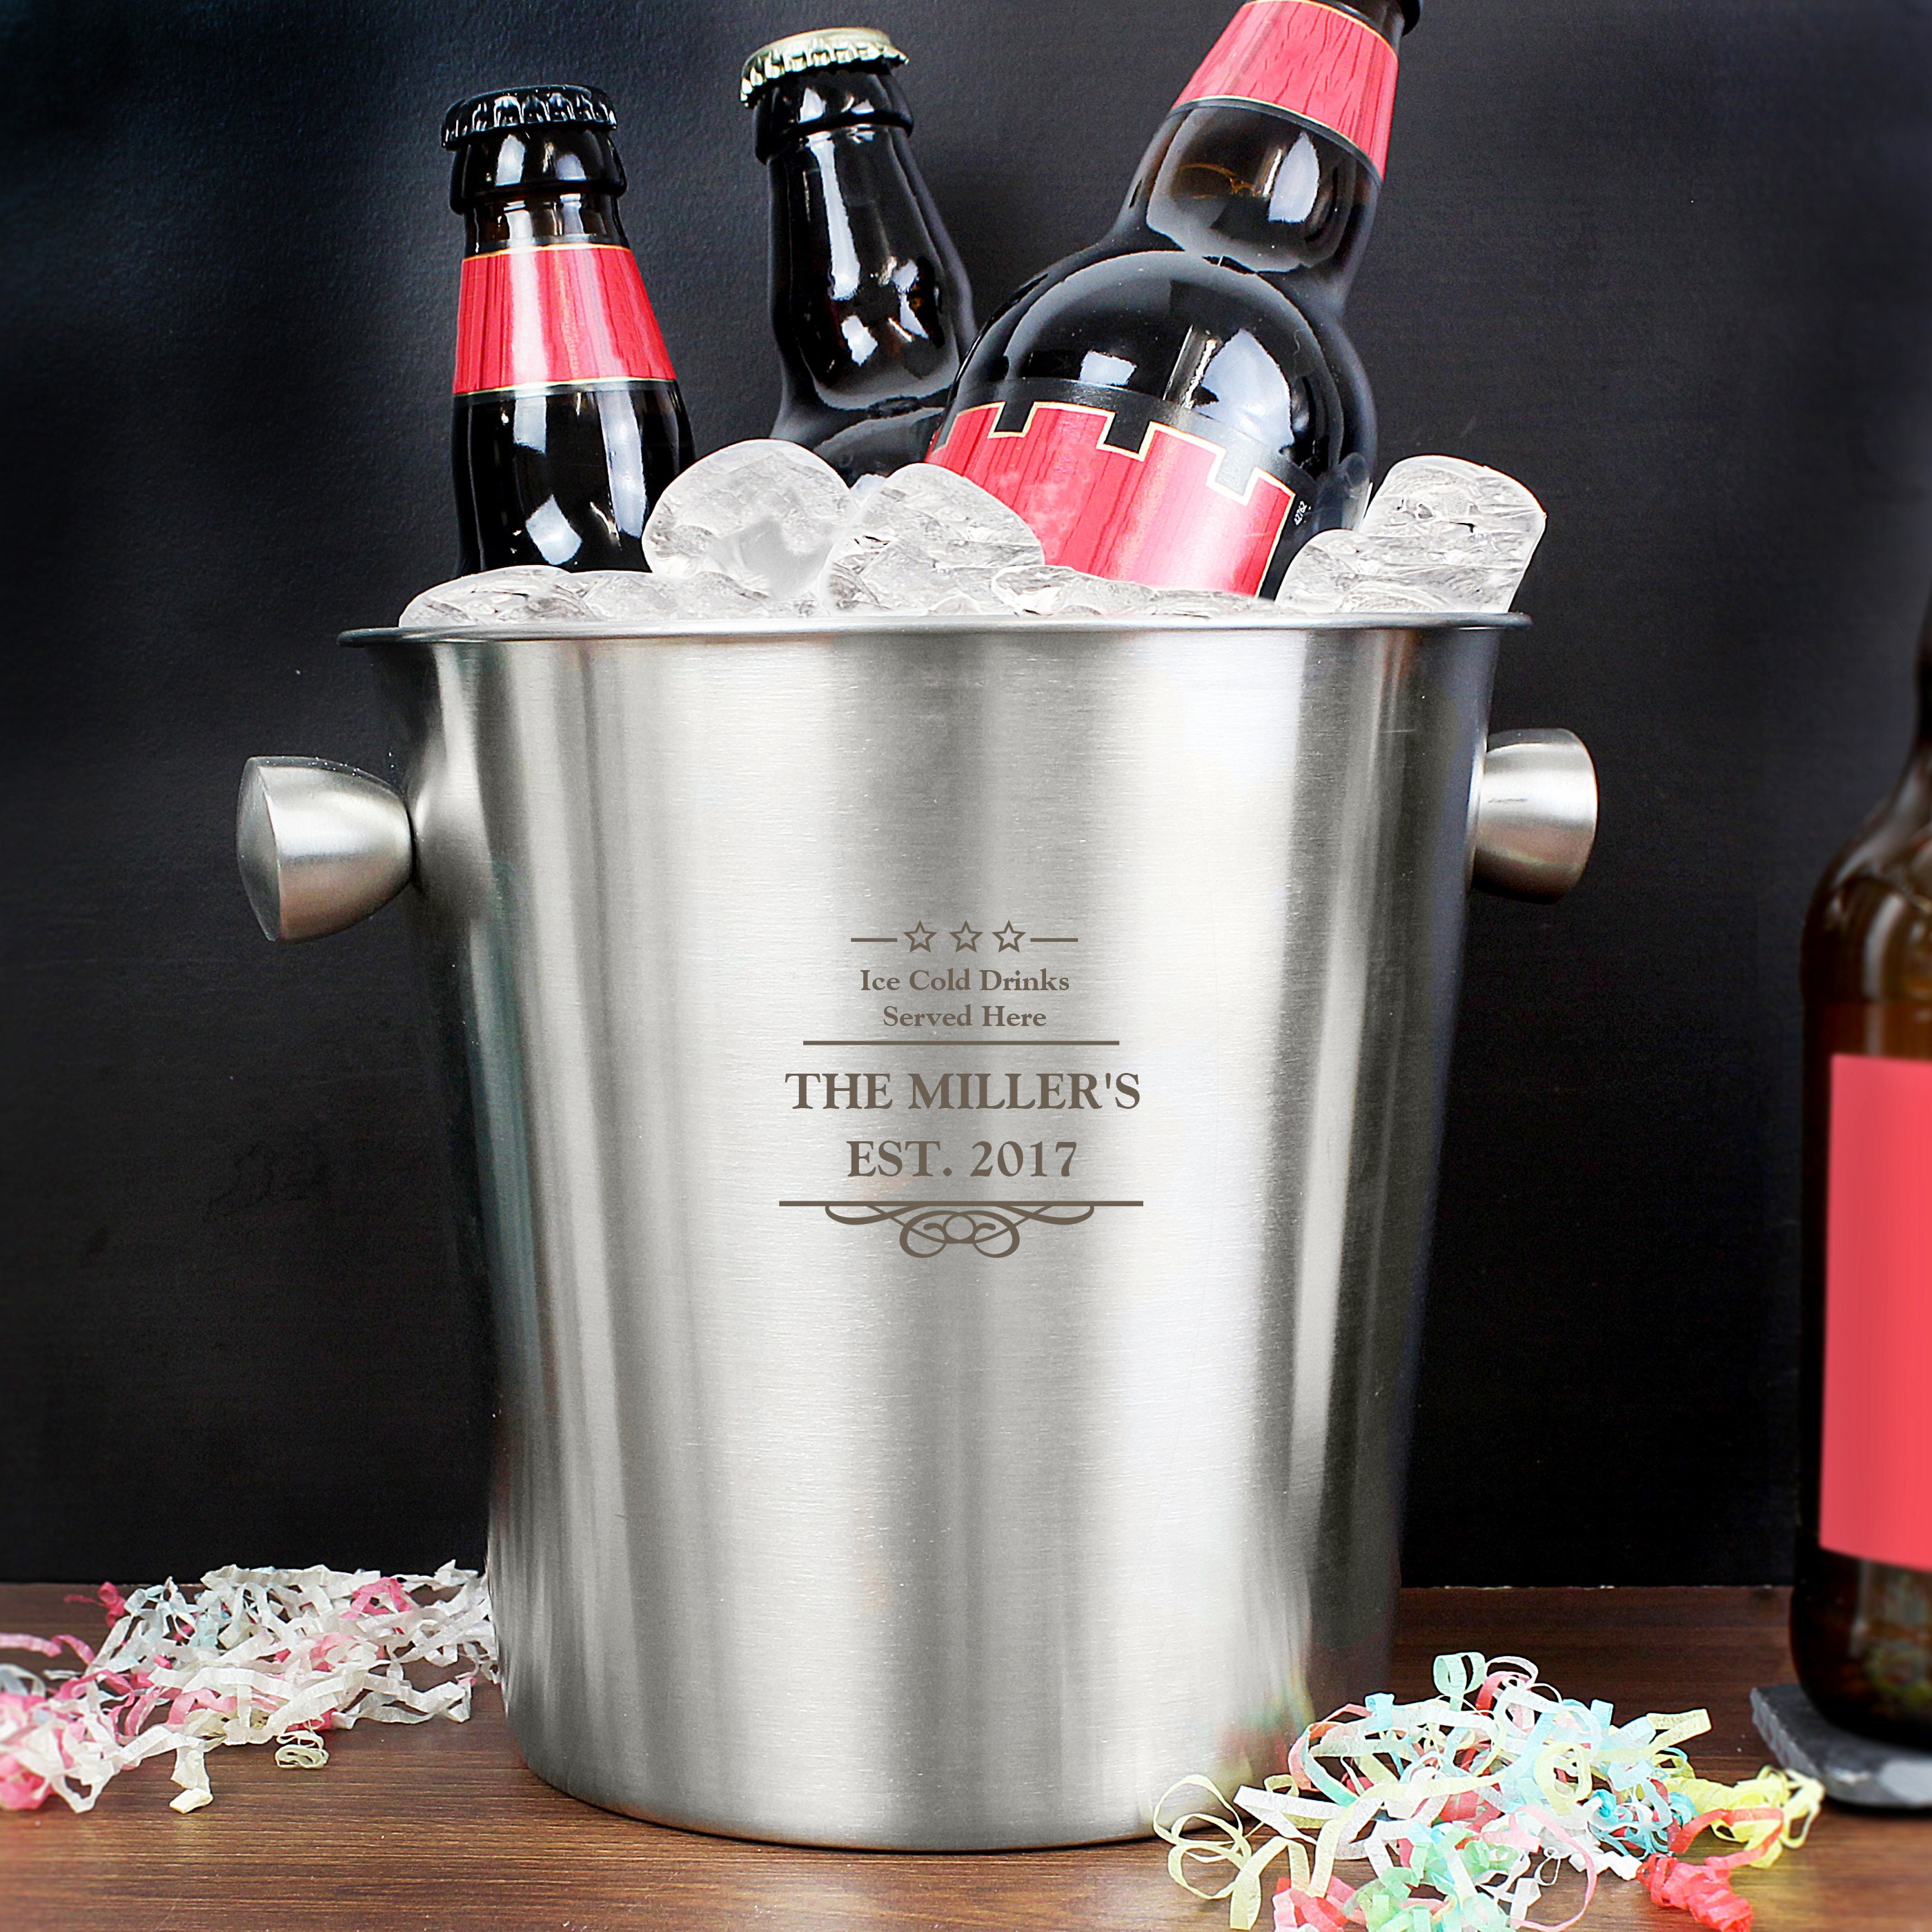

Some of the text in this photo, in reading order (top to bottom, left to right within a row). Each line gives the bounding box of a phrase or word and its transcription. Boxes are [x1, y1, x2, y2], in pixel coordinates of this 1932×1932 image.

[860, 967, 1070, 991] Ice Cold Drinks
[883, 1004, 1047, 1027] Served Here
[785, 1072, 1140, 1110] THE MILLER'S
[846, 1140, 1077, 1177] EST. 2017
